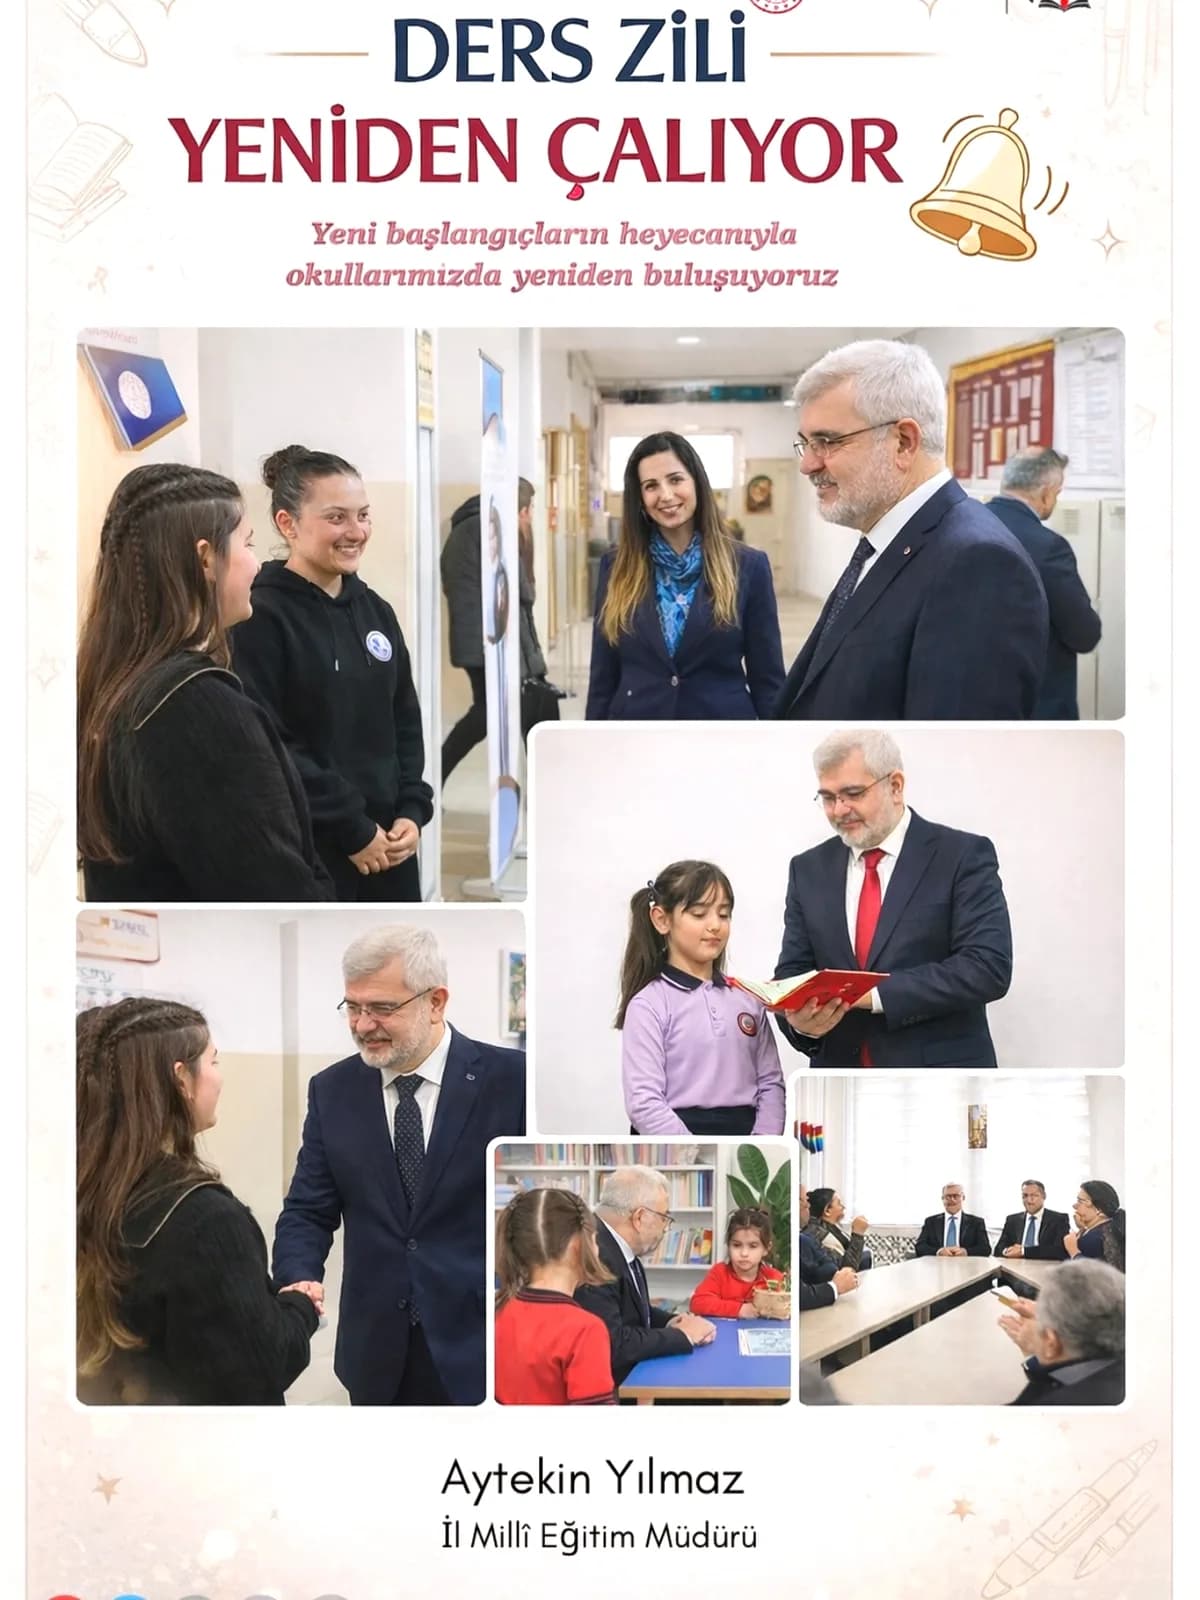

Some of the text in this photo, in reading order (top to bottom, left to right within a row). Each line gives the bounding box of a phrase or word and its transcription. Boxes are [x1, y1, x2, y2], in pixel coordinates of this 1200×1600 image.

[394, 17, 593, 84] DERS
[168, 103, 904, 202] YENİDEN ÇALIYOR
[311, 220, 797, 251] Yeni başlangıçların heyecanıyla
[511, 261, 633, 294] yeniden
[644, 261, 840, 293] buluşuyoruz
[441, 1455, 745, 1507] Aytekin Yılmaz
[442, 1514, 757, 1557] İl Millî Eğitim Müdürü
